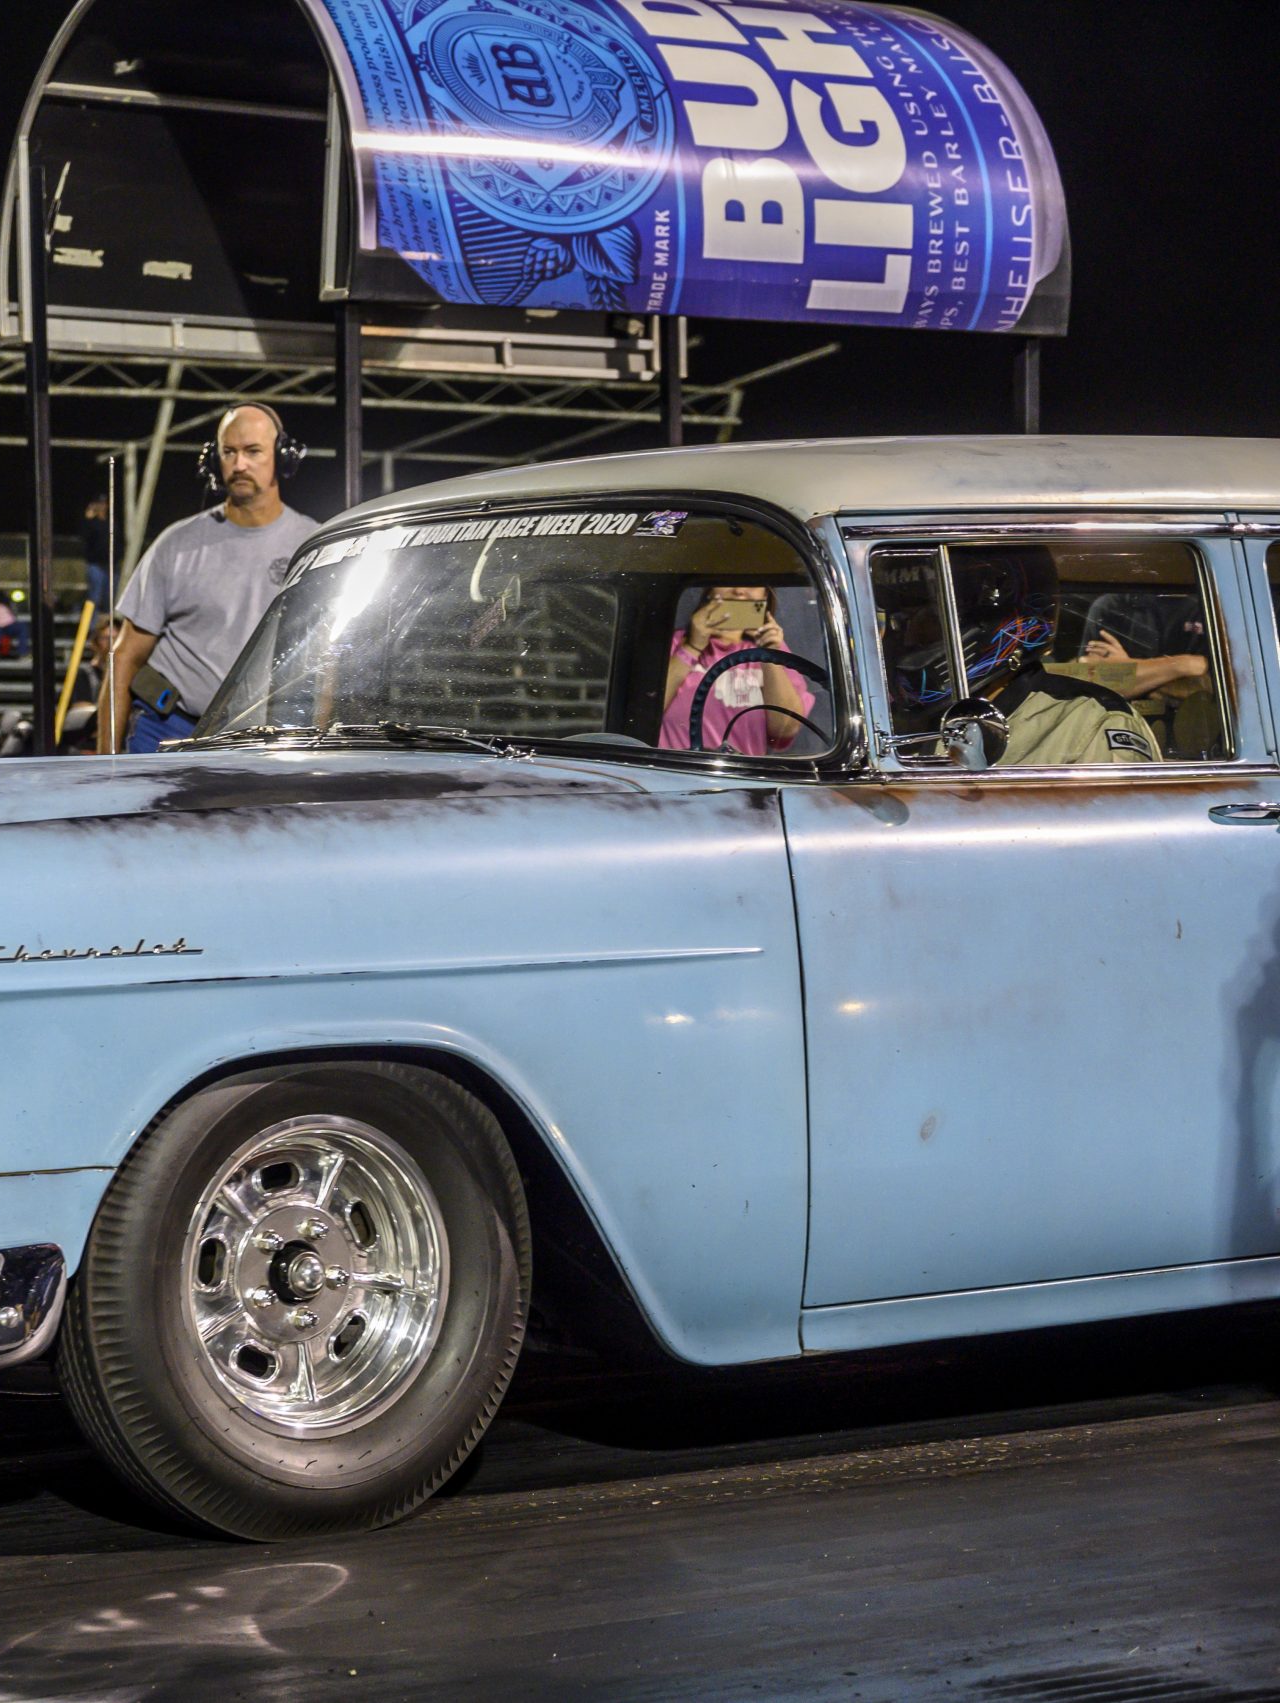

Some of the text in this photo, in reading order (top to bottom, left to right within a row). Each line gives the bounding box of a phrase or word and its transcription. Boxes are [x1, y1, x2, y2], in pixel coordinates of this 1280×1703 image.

[615, 48, 654, 124] AMERICA
[619, 0, 805, 265] BUD
[876, 55, 929, 136] USING
[719, 0, 914, 314] LIGH
[921, 85, 969, 206] BARLEY
[646, 209, 670, 313] TRADE MARK
[921, 150, 945, 274] BREWED
[951, 219, 970, 291] BEST
[410, 519, 497, 548] MOUNTAIN
[491, 516, 543, 540] RACE
[532, 514, 589, 537] WEEK
[579, 513, 639, 536] 2020
